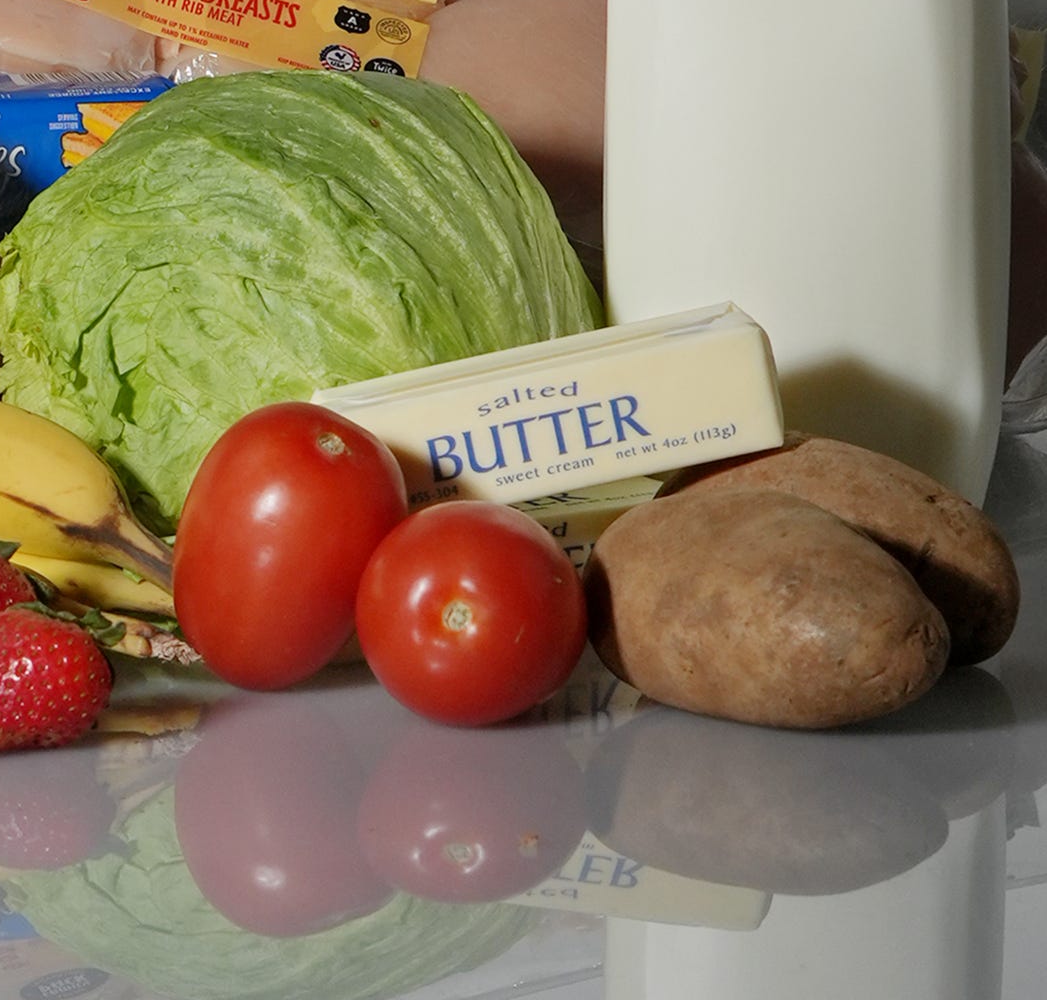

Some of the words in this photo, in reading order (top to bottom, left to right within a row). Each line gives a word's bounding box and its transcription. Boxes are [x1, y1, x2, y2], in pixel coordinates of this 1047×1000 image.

[127, 5, 141, 15] MAY
[141, 11, 168, 26] CONTAIN
[168, 19, 178, 28] UP
[178, 22, 188, 31] TO
[198, 29, 229, 43] RETAINED
[229, 37, 250, 49] WATER
[206, 6, 245, 27] MEAT
[478, 381, 578, 417] salted
[426, 394, 652, 482] BUTTER
[615, 447, 637, 460] net
[641, 443, 658, 454] wt
[663, 436, 688, 449] 4oz
[693, 424, 737, 444] (113g)
[495, 472, 541, 487] sweet
[547, 456, 595, 475] cream
